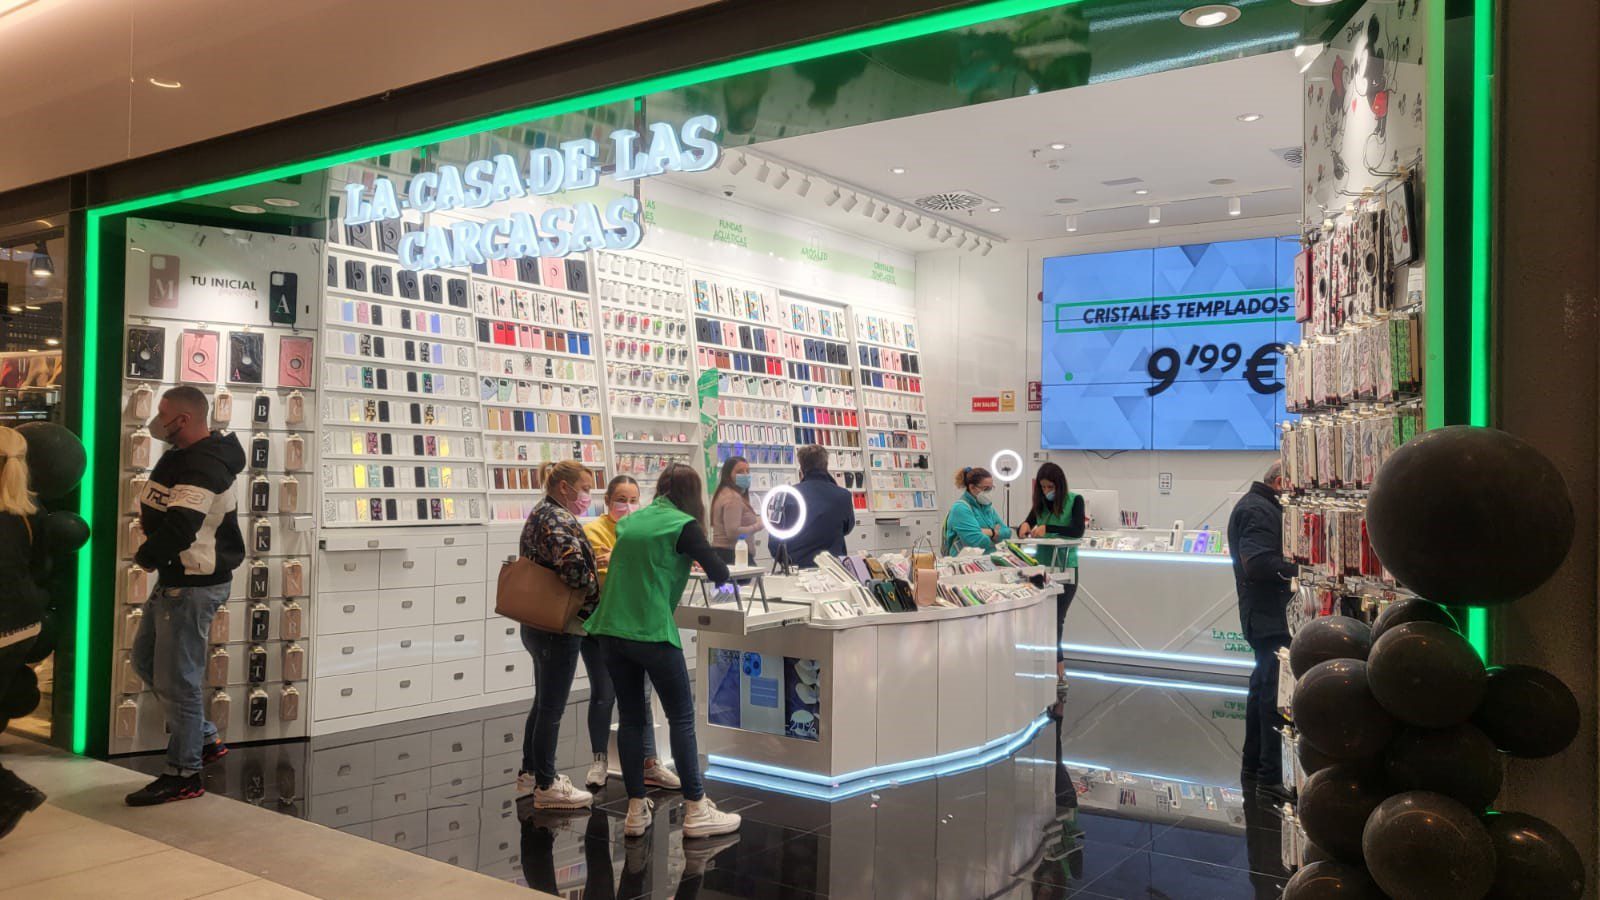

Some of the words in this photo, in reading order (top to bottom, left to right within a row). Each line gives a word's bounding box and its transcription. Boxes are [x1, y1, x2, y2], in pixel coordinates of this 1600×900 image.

[344, 177, 400, 225] LA
[408, 153, 526, 212] CASA
[529, 138, 600, 194] DE
[610, 114, 721, 180] LAS
[398, 196, 642, 270] CARCASAS
[190, 275, 207, 287] TU
[211, 276, 257, 291] INICIAL
[275, 294, 291, 314] A
[1083, 303, 1171, 324] CRISTALES
[1177, 296, 1289, 319] TEMPLADOS
[131, 363, 141, 376] L
[233, 368, 241, 380] A
[257, 404, 267, 417] B
[255, 449, 266, 462] E
[254, 494, 266, 507] H
[258, 536, 269, 549] K
[255, 580, 265, 592] M
[256, 624, 266, 636] P
[1226, 632, 1244, 641] CAS
[254, 665, 263, 677] T
[255, 709, 264, 722] Z
